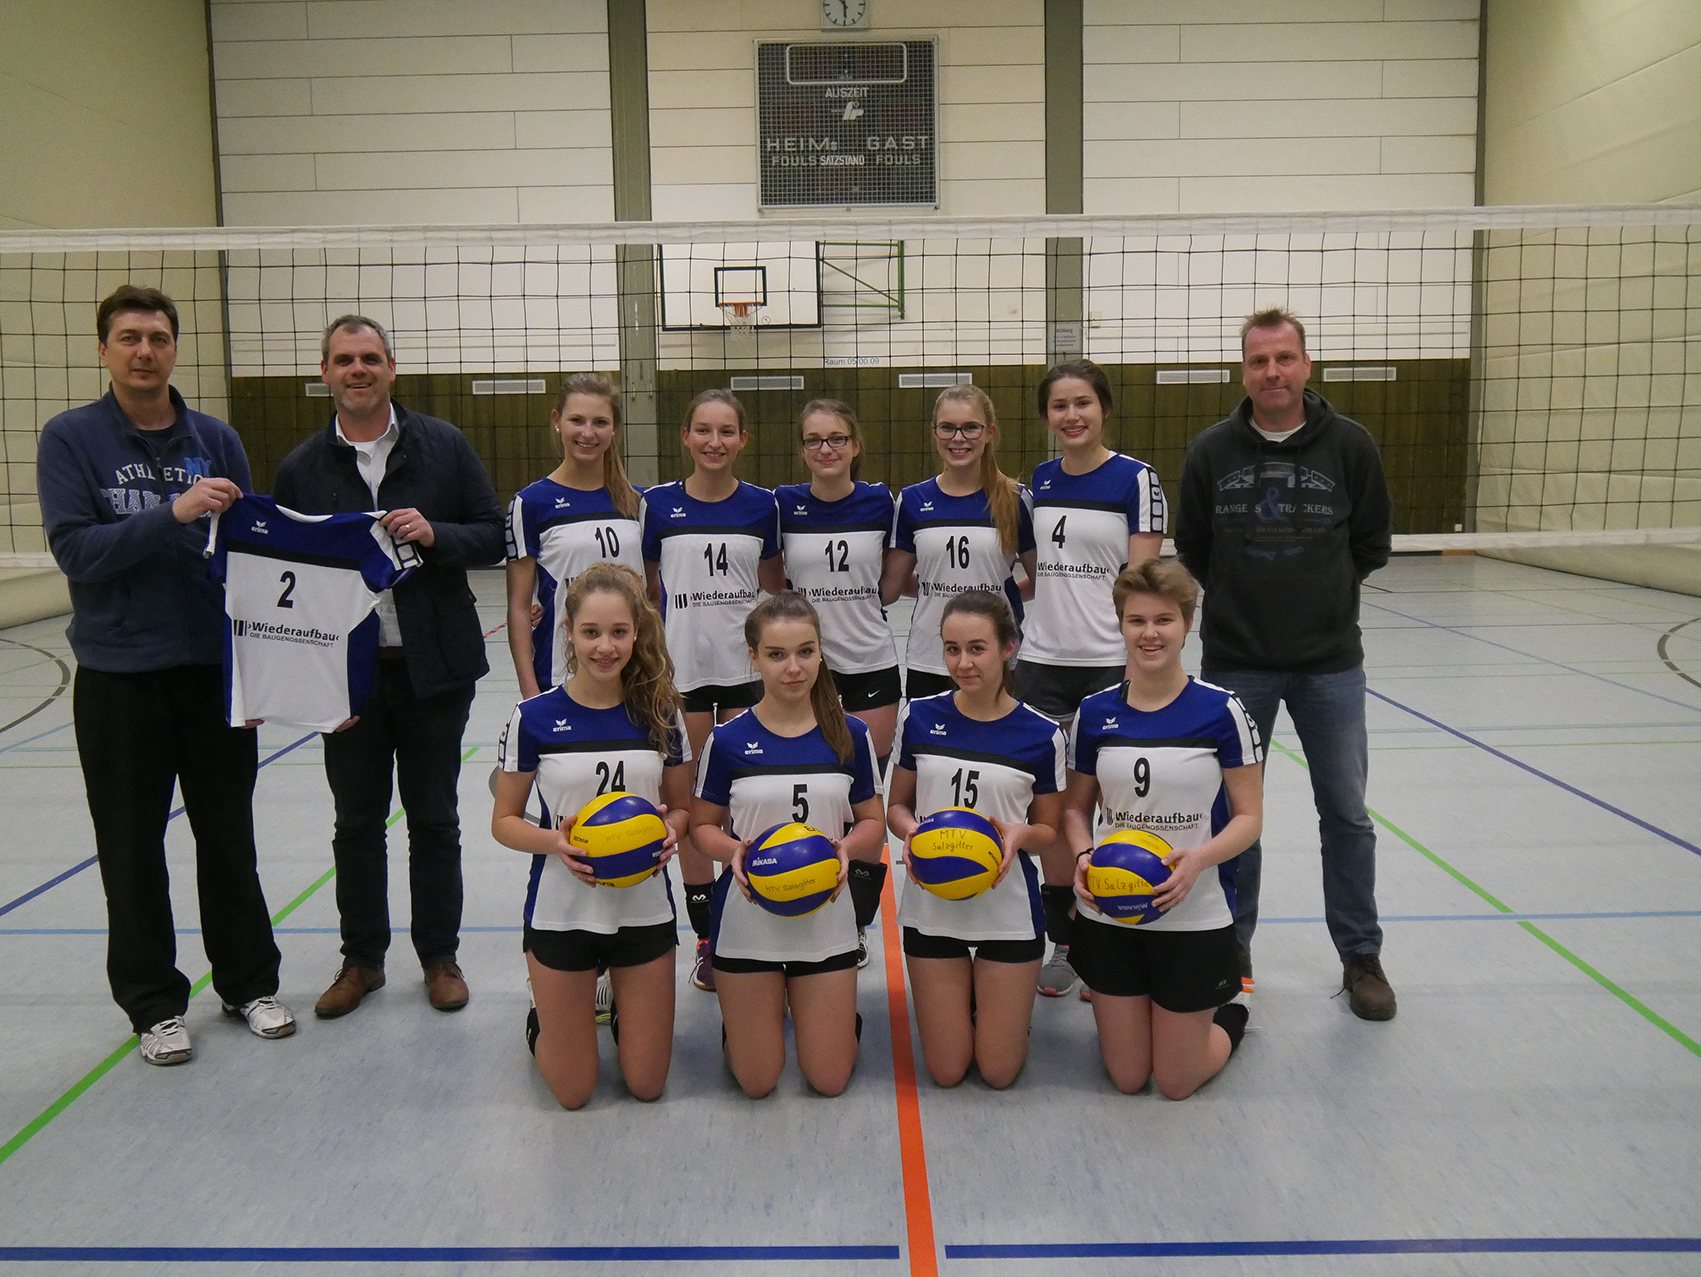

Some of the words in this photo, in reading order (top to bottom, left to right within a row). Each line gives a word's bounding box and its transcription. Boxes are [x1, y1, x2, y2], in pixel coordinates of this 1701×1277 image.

[825, 87, 869, 98] AUSZEIT
[766, 137, 831, 152] HEIM
[867, 136, 929, 150] GAST
[772, 155, 817, 167] FOULS
[820, 155, 865, 166] SATZSTAND
[876, 154, 921, 165] FOULS
[847, 357, 880, 365] 0500.09
[1215, 504, 1262, 514] RANGES
[594, 526, 620, 558] 10
[1051, 515, 1067, 549] 4
[704, 543, 728, 577] 14
[824, 540, 849, 572] 12
[946, 535, 970, 569] 16
[277, 570, 296, 609] 2
[595, 760, 626, 797] 24
[951, 768, 980, 810] 15
[1134, 757, 1150, 798] 9
[791, 784, 810, 823] 5
[940, 829, 968, 839] MTV
[932, 840, 974, 853] Salzgitter
